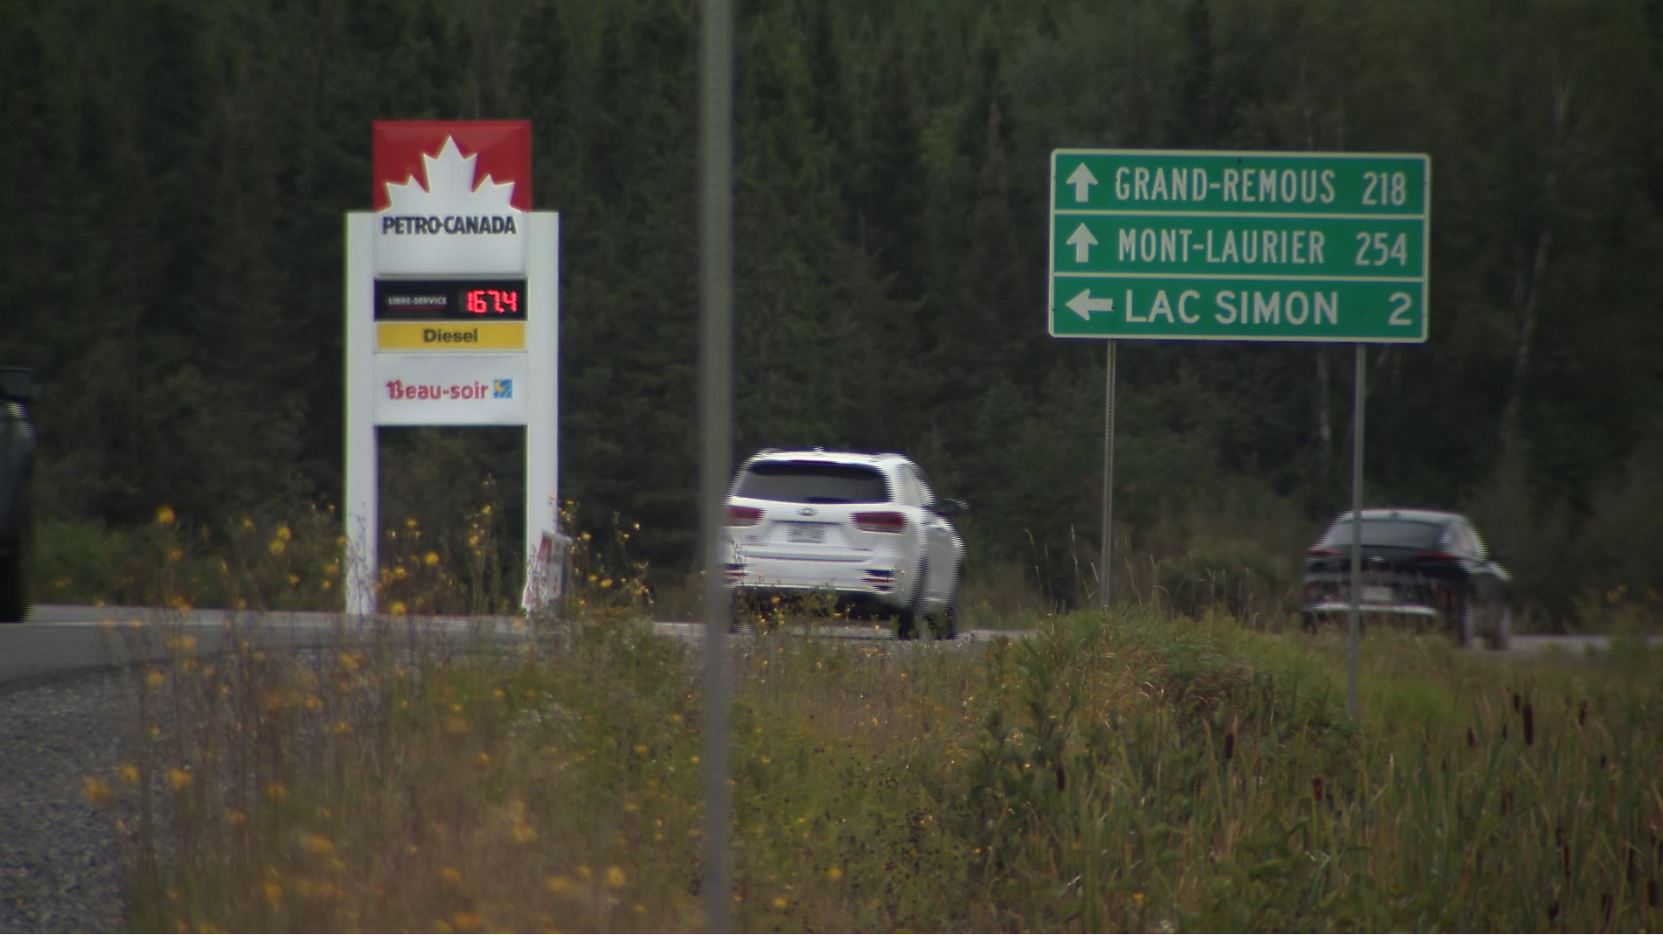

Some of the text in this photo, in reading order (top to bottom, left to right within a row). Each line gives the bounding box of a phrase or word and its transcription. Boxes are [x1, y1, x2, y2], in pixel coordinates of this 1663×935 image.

[1115, 167, 1407, 206] GRAND-REMOUS 218
[1118, 228, 1408, 267] MONT-LAURIER 254
[1125, 289, 1413, 326] LAC SIMON 2
[423, 328, 479, 344] Diesel
[386, 380, 488, 400] Beau-soir
